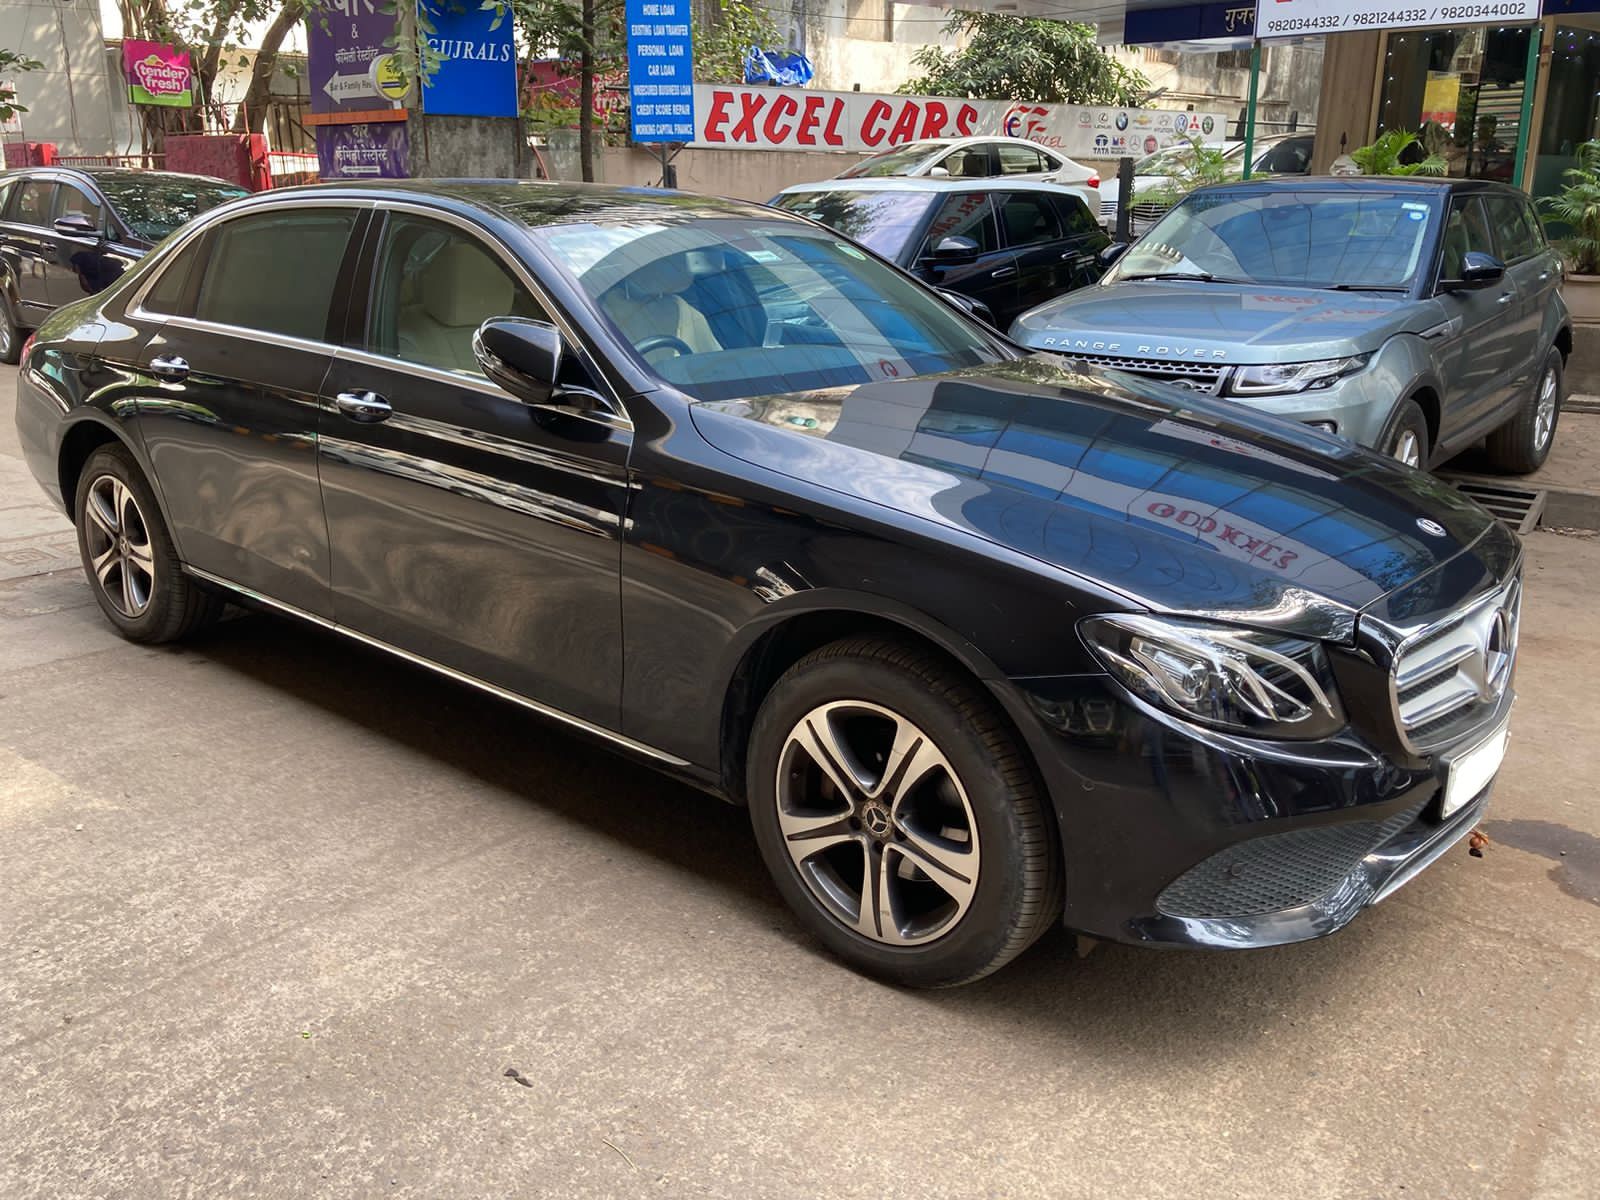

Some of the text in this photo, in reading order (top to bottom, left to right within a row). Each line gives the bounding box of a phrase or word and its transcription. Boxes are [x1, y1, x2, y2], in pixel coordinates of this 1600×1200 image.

[643, 4, 675, 16] HOME LOAN
[1267, 15, 1340, 33] 9820344332
[1352, 9, 1426, 26] 9821244332
[1440, 2, 1526, 20] 9820344002
[653, 24, 665, 36] LOAN
[427, 38, 511, 62] GUJRALS
[638, 44, 684, 56] PERSONAL LOAN
[140, 64, 185, 80] tender
[648, 64, 675, 76] CAR LOAN
[146, 75, 181, 91] fresh
[636, 104, 690, 115] CREDIT SCORE REPAIR
[704, 91, 978, 147] EXCEL CARS
[1093, 147, 1110, 155] TATA
[1043, 337, 1227, 359] RANGE ROVER
